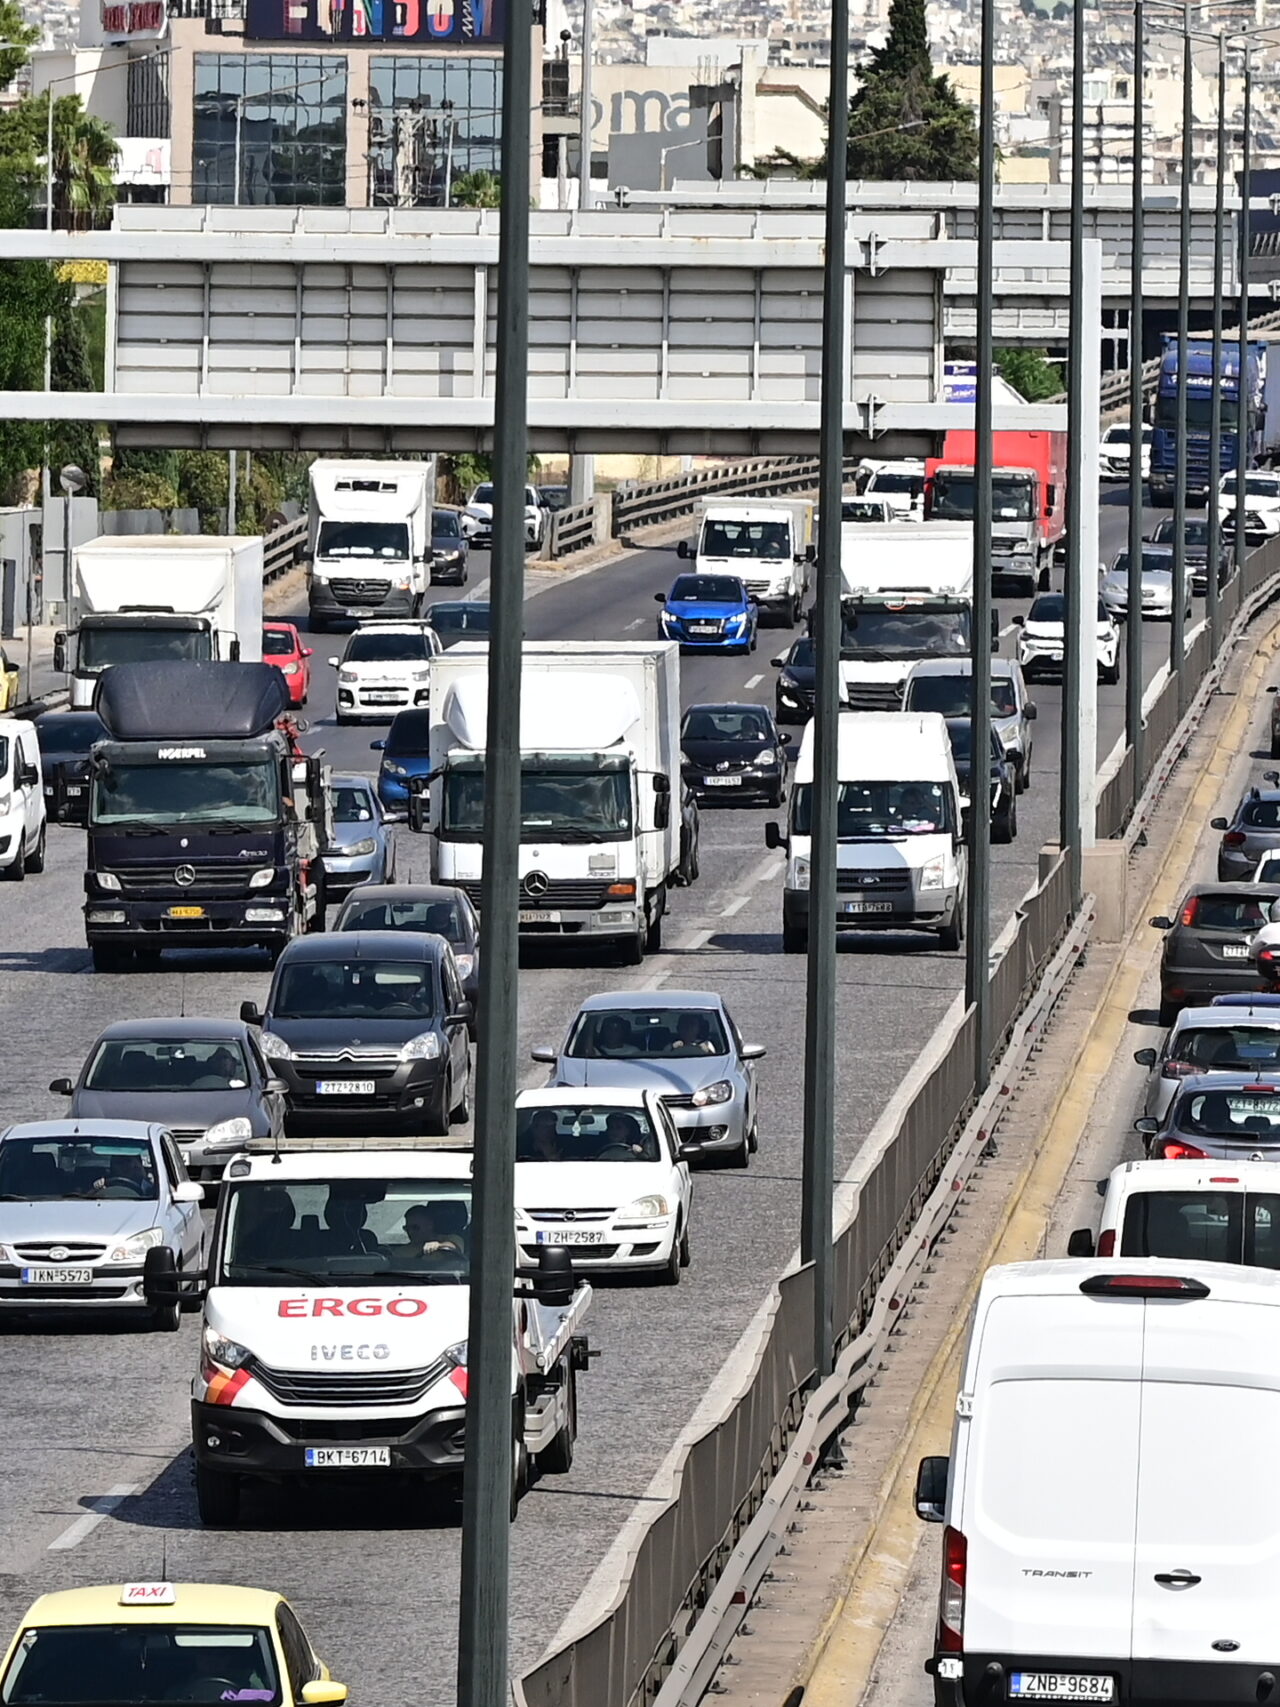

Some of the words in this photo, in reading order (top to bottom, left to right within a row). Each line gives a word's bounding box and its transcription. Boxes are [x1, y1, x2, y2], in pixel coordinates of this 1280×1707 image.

[278, 1298, 428, 1318] ERGO
[311, 1344, 390, 1361] IVECO
[317, 1450, 387, 1464] BKT-6714
[1021, 1569, 1093, 1579] TRANSIT
[129, 1587, 168, 1598] TAXI
[1026, 1675, 1110, 1695] ZNB-9684
